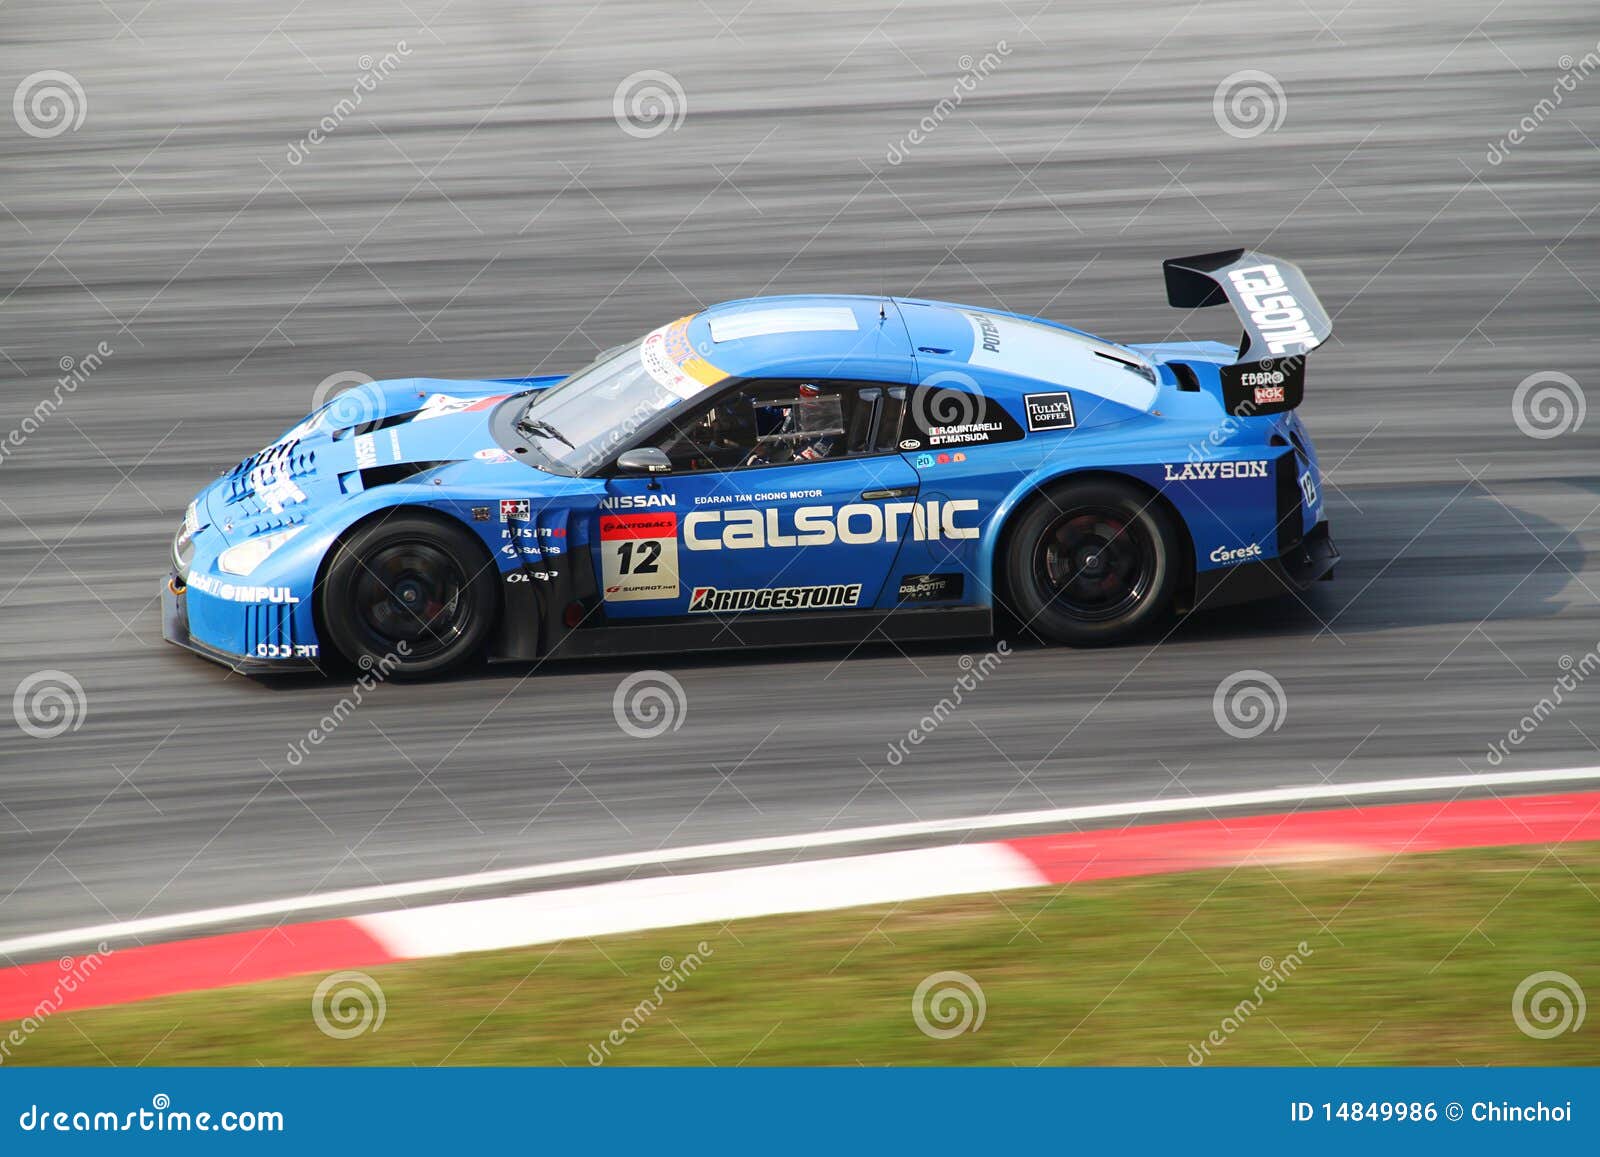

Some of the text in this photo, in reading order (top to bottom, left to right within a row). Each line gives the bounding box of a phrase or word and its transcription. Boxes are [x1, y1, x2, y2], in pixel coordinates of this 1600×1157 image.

[1241, 371, 1284, 386] EBBRO
[1035, 413, 1067, 421] COFFEE
[940, 422, 1002, 434] R.QUINTARELLI
[940, 432, 989, 444] T.MATSUDA
[1165, 460, 1268, 480] LAWSON
[599, 494, 676, 509] NISSAN
[695, 490, 823, 504] EDARAN TAN CHONG MOTOR
[617, 541, 662, 575] 12
[1209, 543, 1262, 562] Carest
[689, 584, 862, 612] BRIDGESTONE
[257, 643, 319, 657] COCPIT
